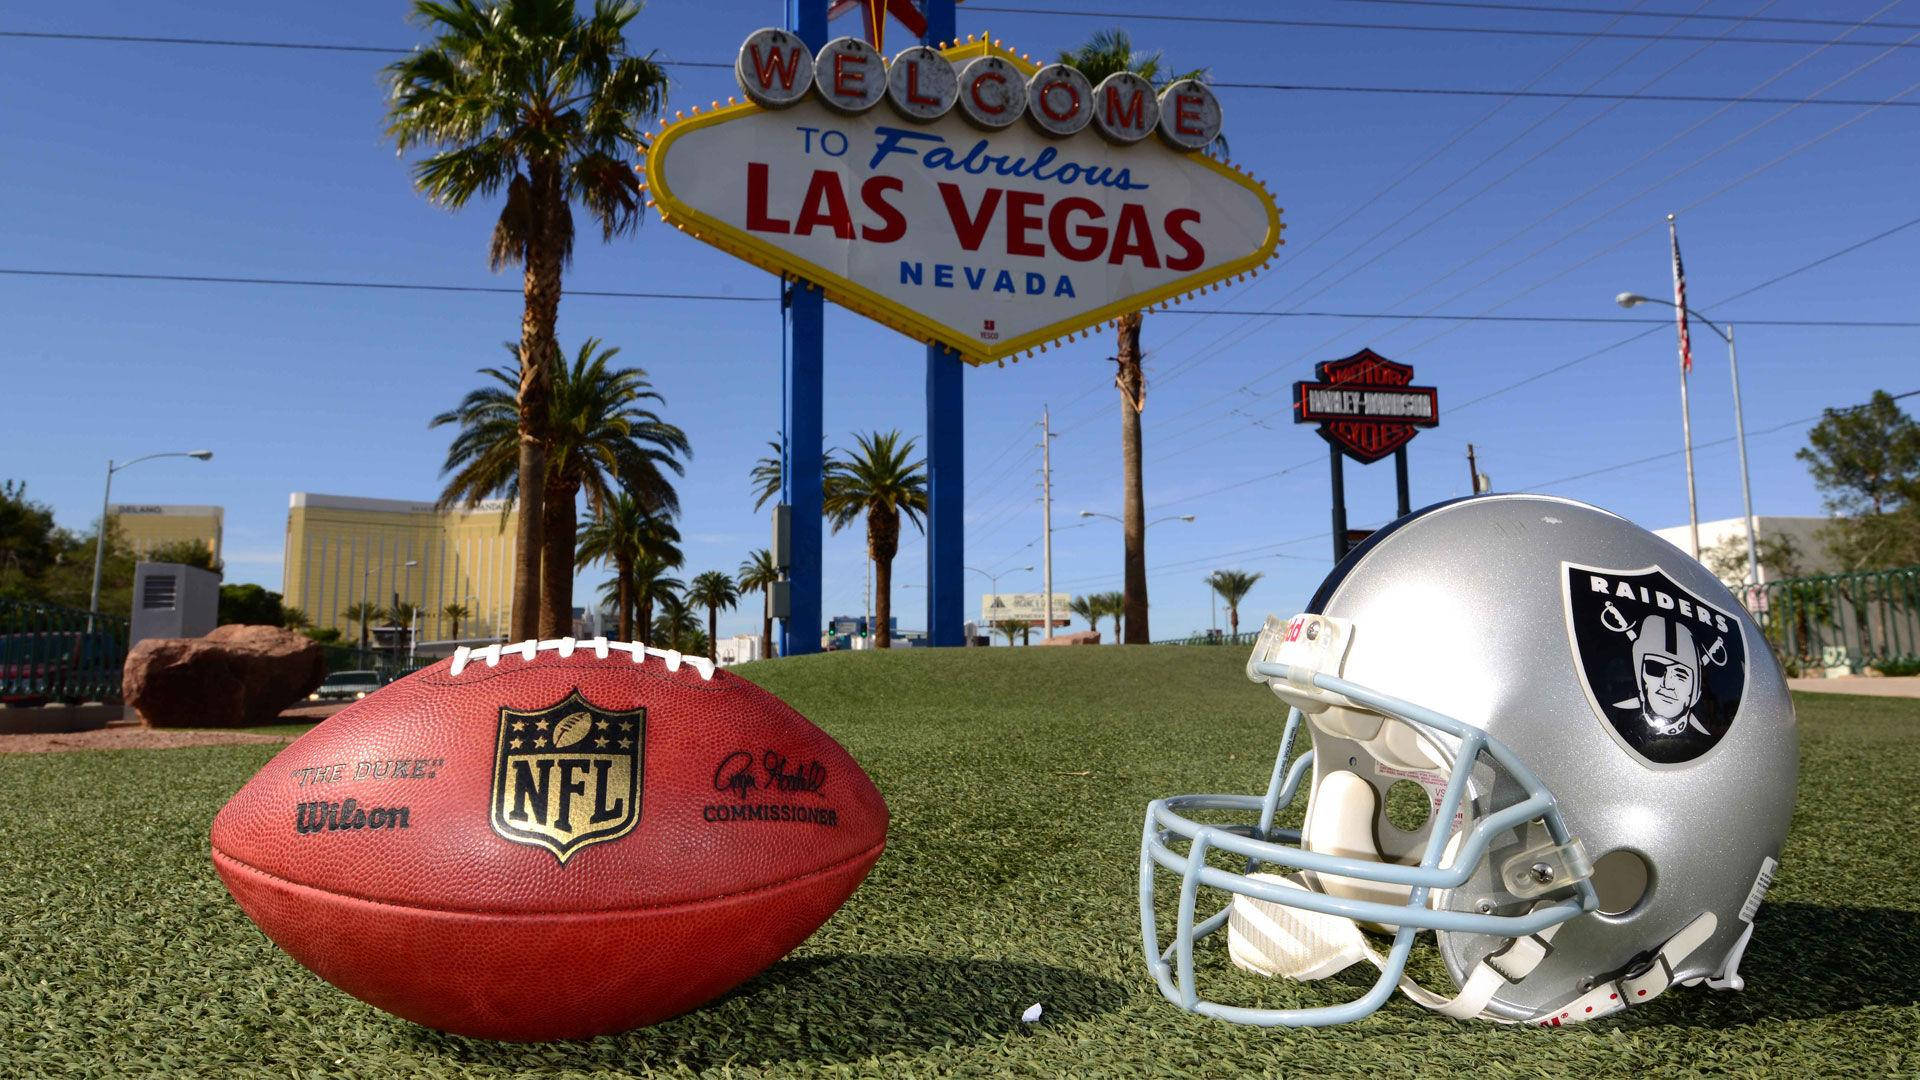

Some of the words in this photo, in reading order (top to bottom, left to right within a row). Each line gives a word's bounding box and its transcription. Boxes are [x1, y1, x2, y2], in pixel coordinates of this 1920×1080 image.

[748, 42, 1203, 136] WELCOME
[797, 127, 849, 157] TO
[869, 126, 1149, 191] Fabulous
[746, 162, 908, 244] LAS
[937, 182, 1206, 272] VEGAS
[900, 260, 1076, 299] NEVADA
[1590, 575, 1729, 633] RAIDERS
[296, 797, 410, 834] Wilson
[508, 756, 625, 833] NFL
[703, 803, 838, 828] COMMISSIONER
